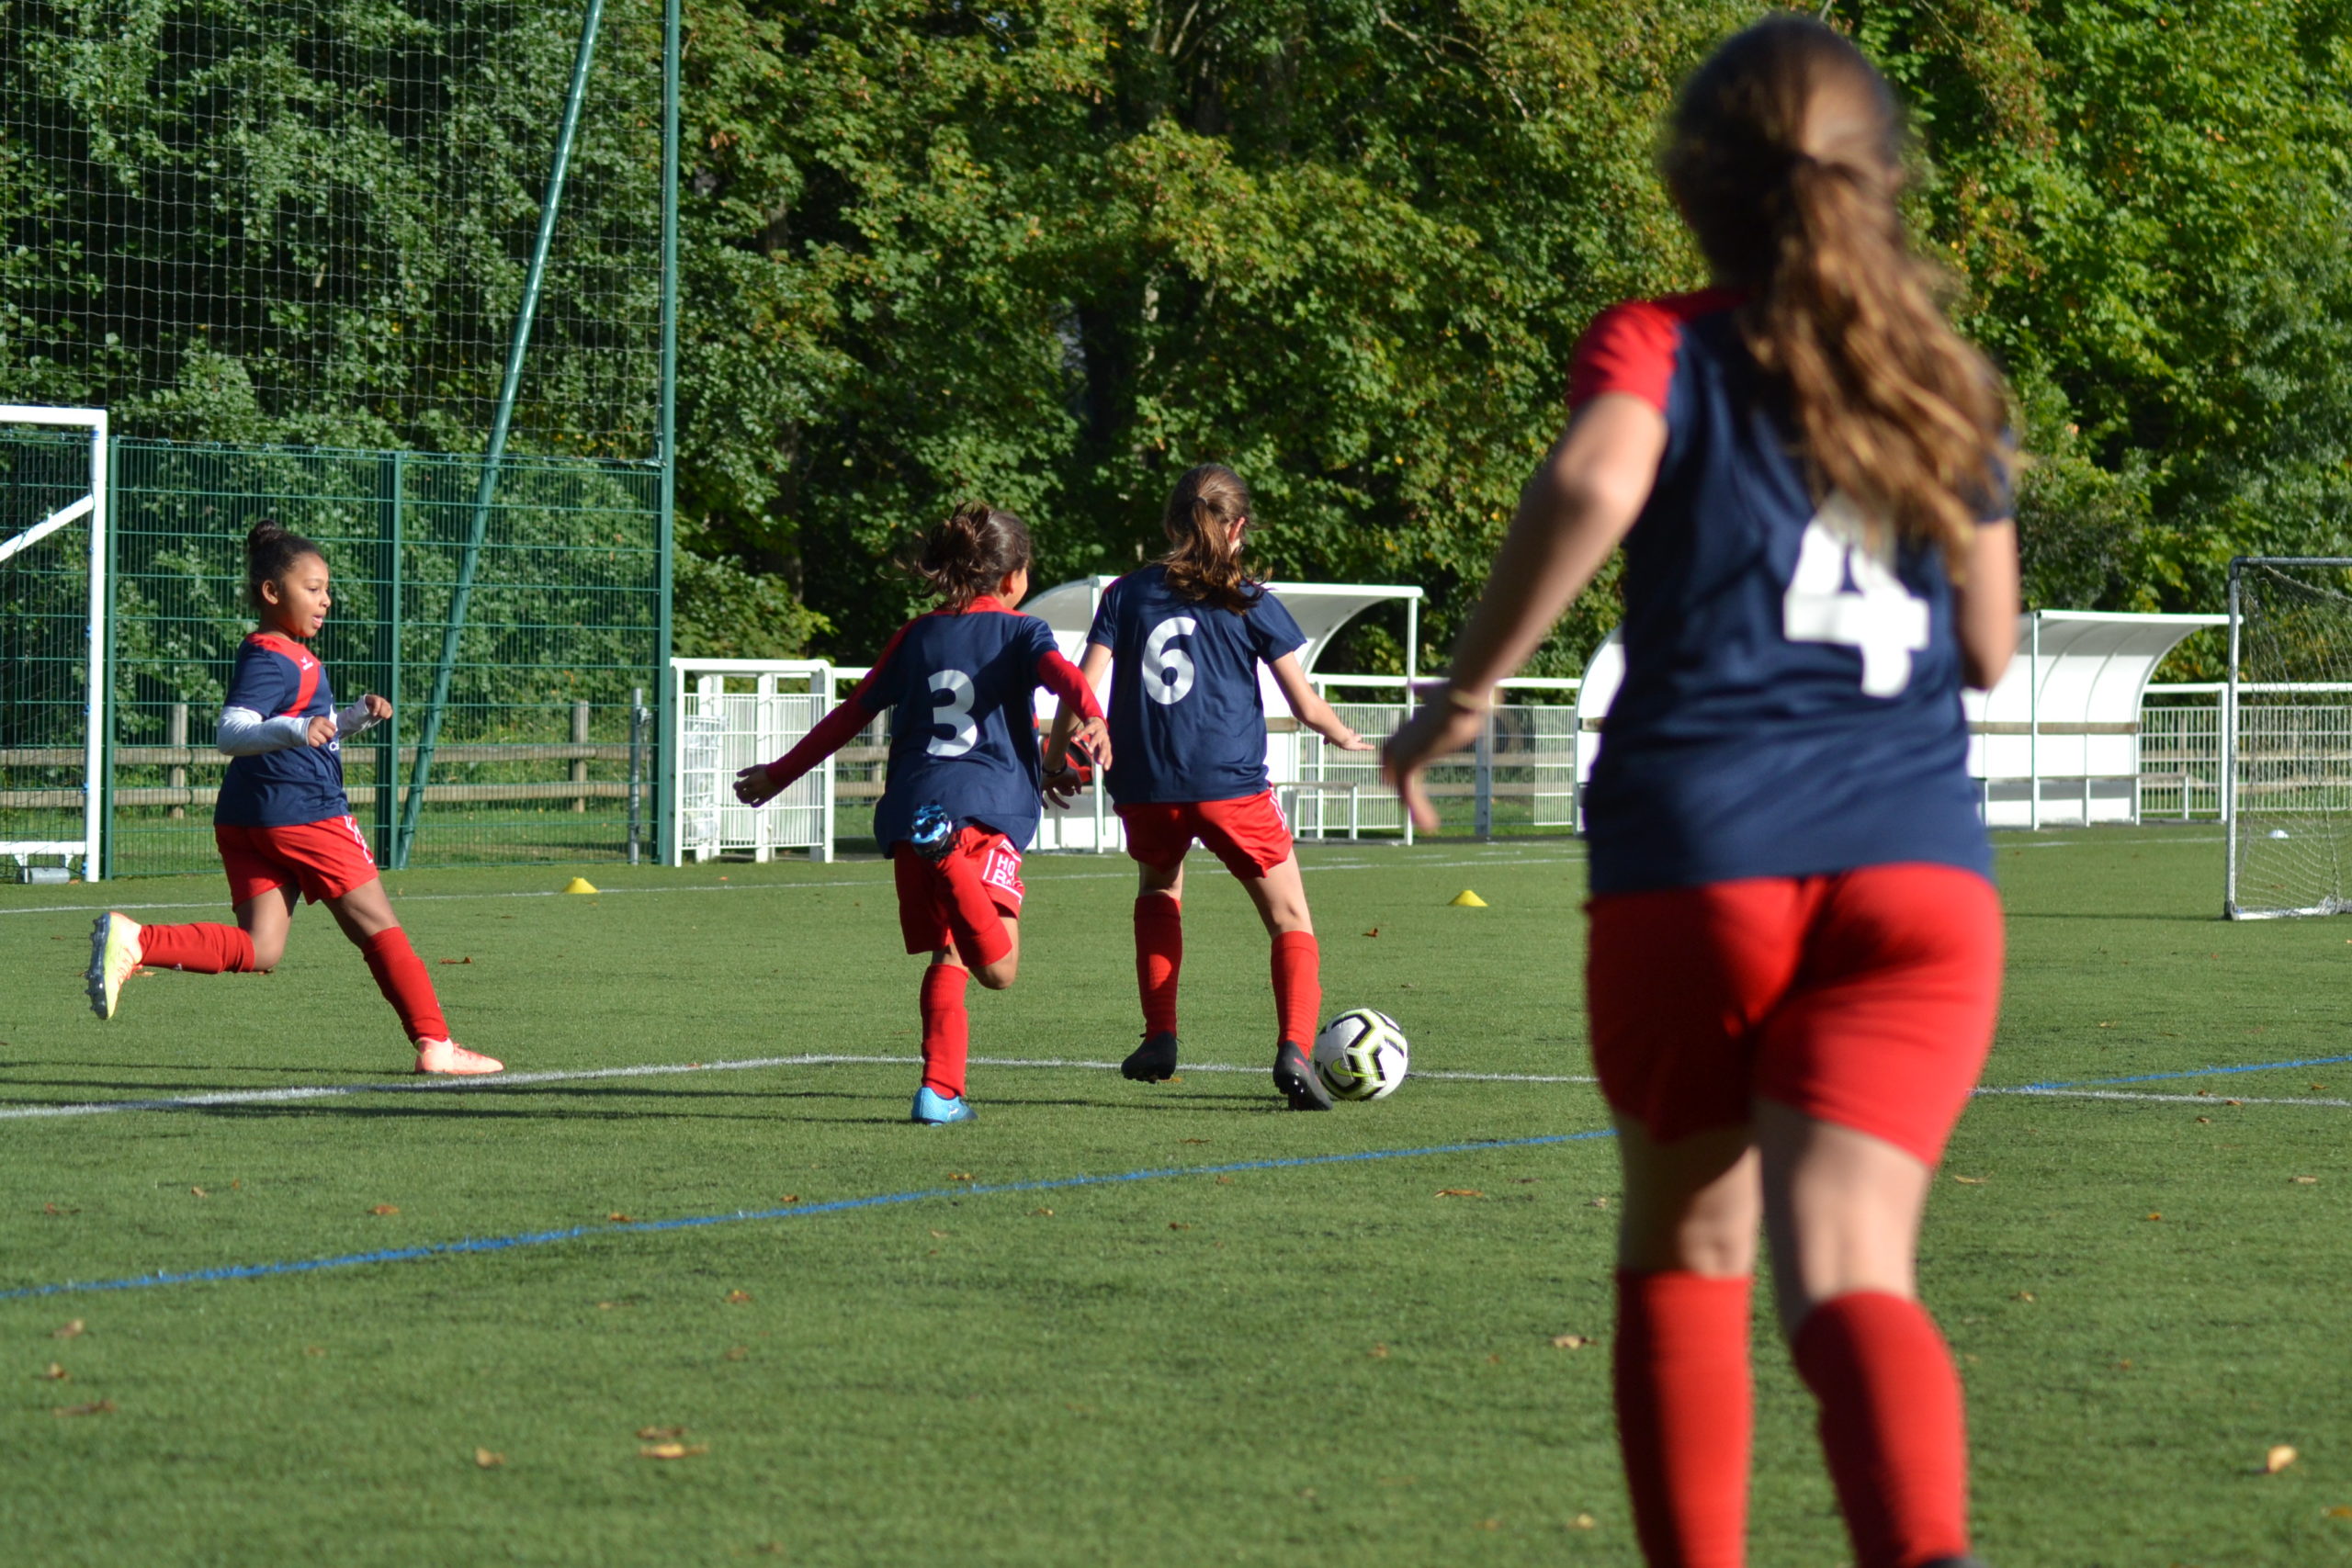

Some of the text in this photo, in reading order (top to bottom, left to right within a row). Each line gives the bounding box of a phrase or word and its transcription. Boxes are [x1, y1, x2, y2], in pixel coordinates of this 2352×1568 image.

[1783, 491, 1929, 698] 4
[1142, 616, 1196, 705] 6
[926, 670, 978, 757] 3
